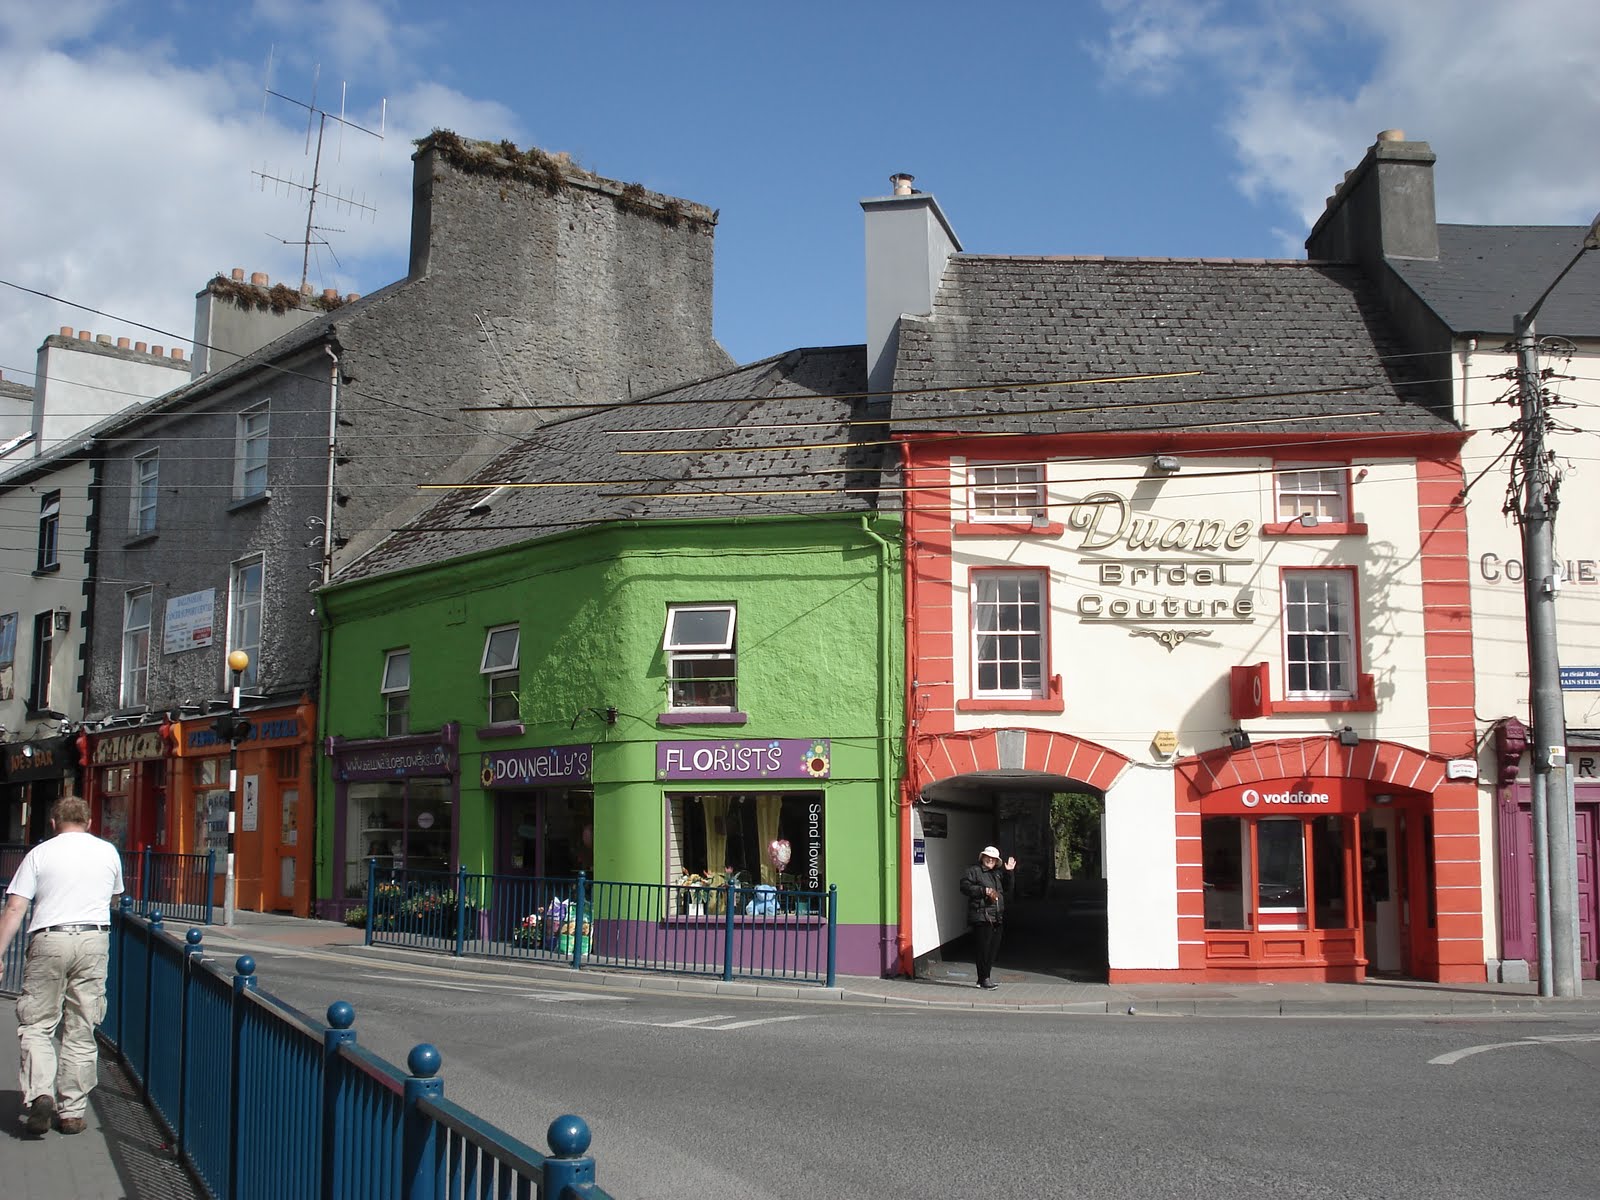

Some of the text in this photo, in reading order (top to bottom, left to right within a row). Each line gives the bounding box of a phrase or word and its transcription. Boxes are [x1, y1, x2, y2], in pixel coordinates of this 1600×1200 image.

[1069, 490, 1254, 550] Duane
[1101, 563, 1227, 583] Bridal
[1079, 594, 1254, 615] Couture
[11, 750, 53, 772] JOES BAR
[666, 748, 782, 771] FLORISTS
[1263, 792, 1329, 804] vodafone
[808, 803, 821, 889] Send flowers
